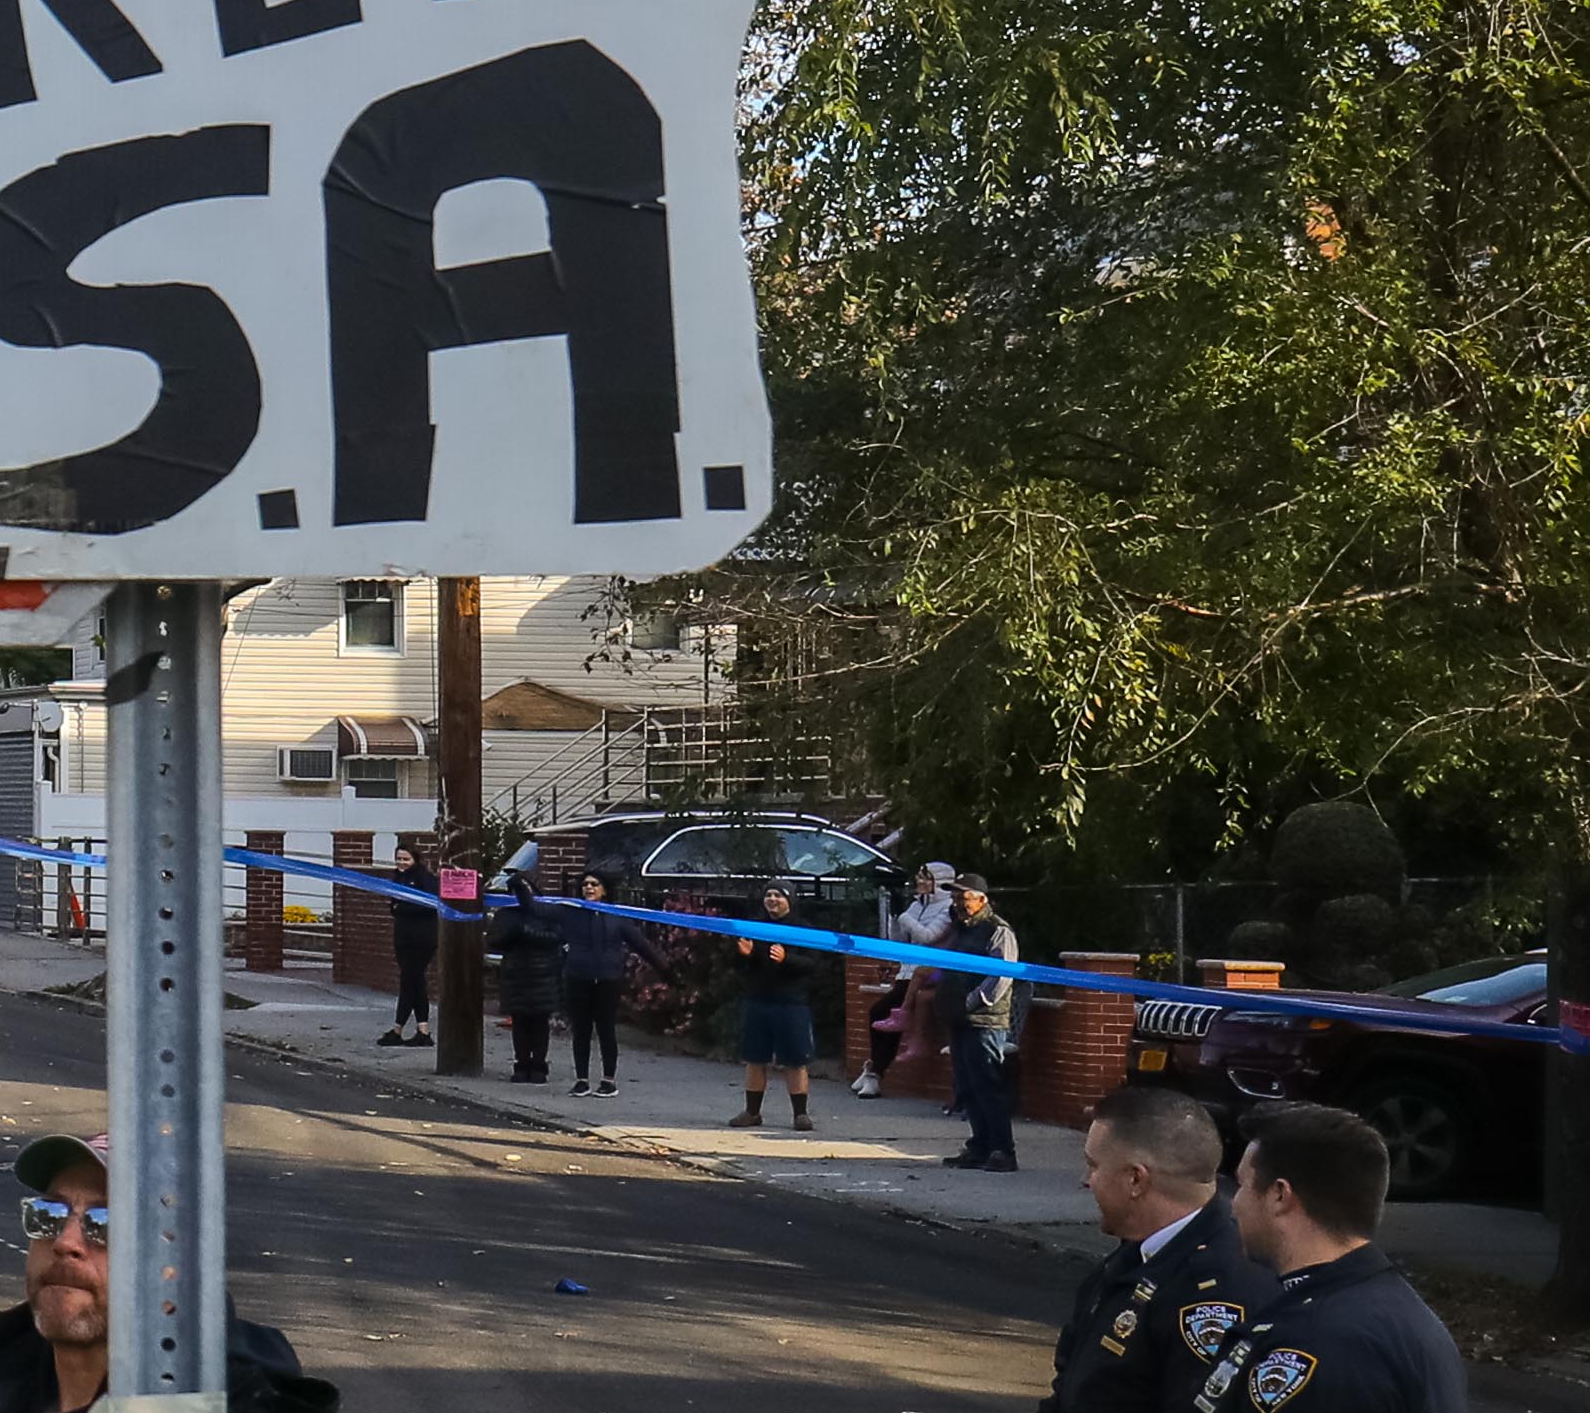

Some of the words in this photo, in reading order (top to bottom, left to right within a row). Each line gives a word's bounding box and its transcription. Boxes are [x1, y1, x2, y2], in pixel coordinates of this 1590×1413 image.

[1196, 1305, 1227, 1315] POLICE
[1185, 1312, 1238, 1324] DEPARTMENT
[1186, 1330, 1198, 1346] CITY
